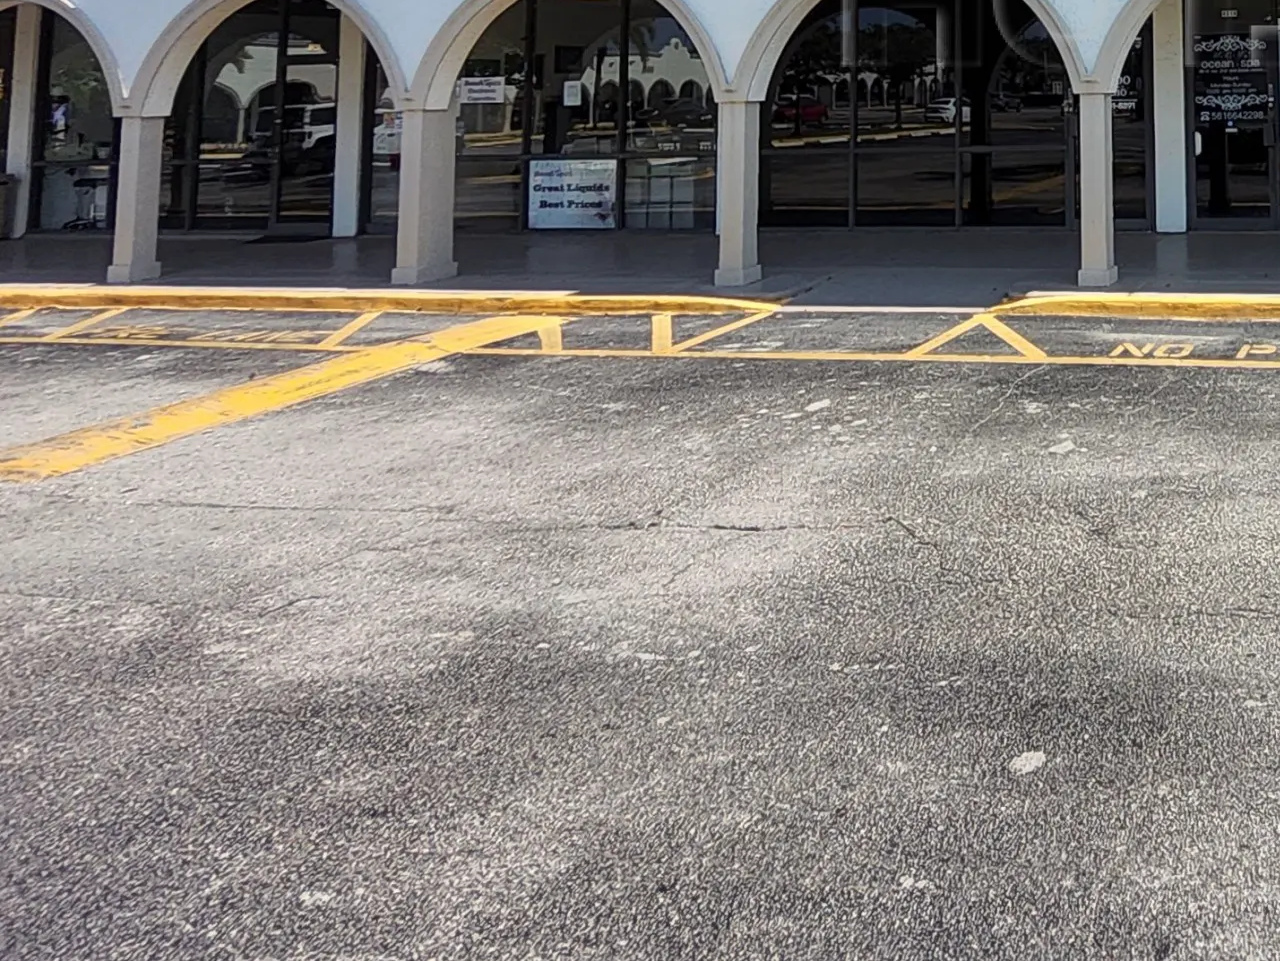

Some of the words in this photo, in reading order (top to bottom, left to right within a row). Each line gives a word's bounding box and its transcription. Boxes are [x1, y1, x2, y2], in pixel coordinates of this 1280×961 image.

[1200, 59, 1234, 69] ocean
[1240, 59, 1261, 69] spa
[533, 183, 565, 192] Great
[566, 183, 610, 193] Liquids
[539, 200, 565, 209] Best
[1109, 342, 1194, 358] NO
